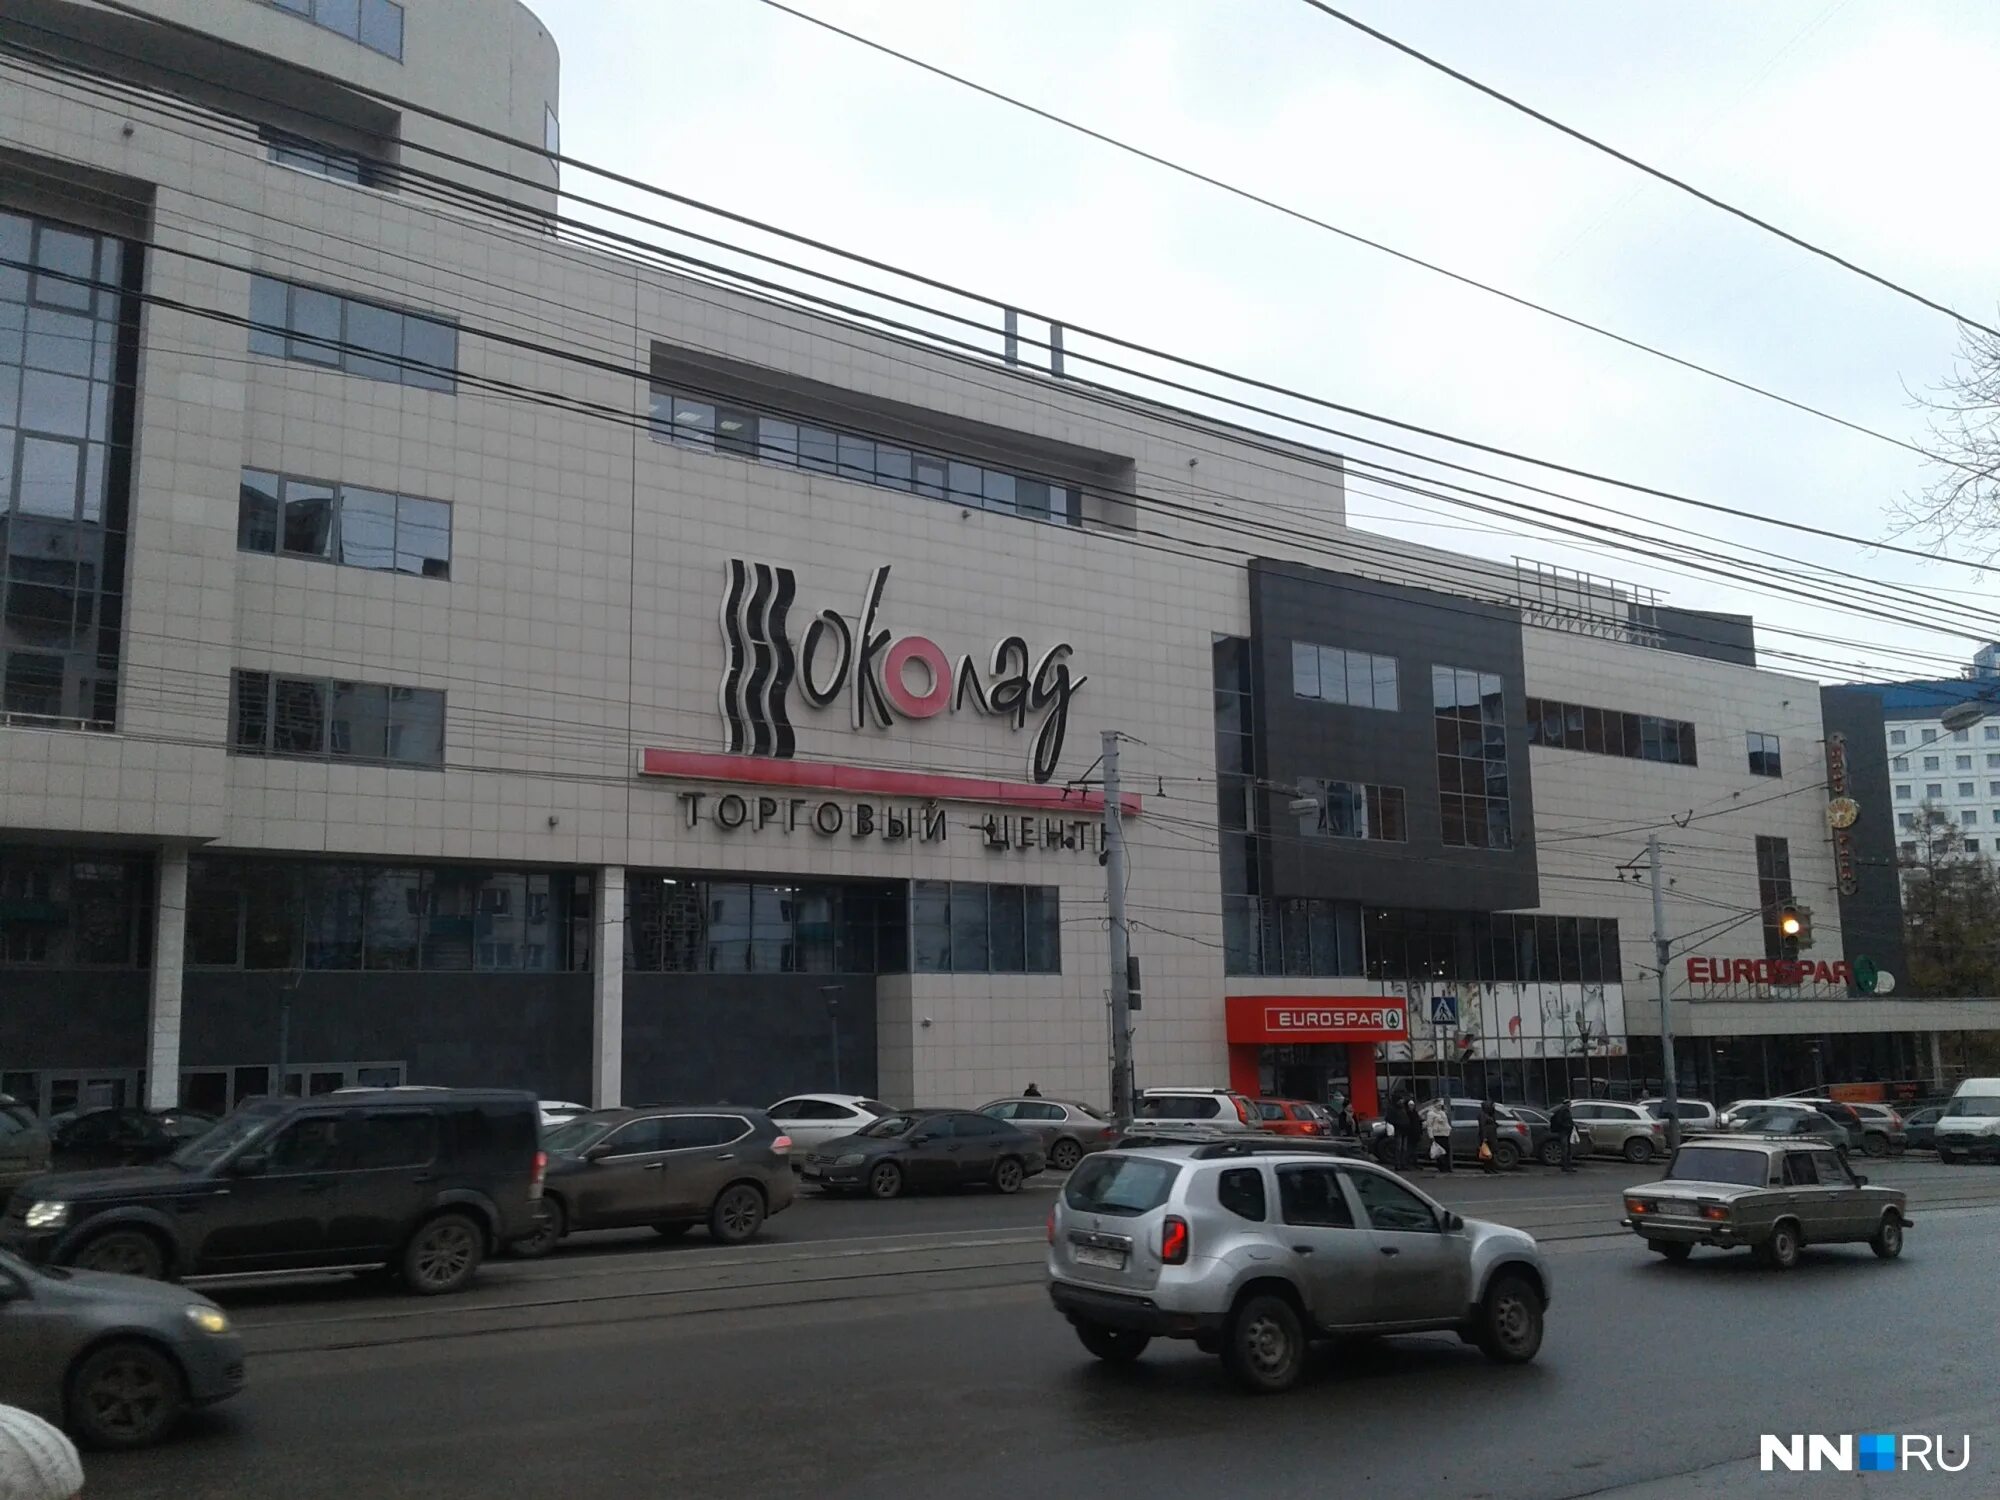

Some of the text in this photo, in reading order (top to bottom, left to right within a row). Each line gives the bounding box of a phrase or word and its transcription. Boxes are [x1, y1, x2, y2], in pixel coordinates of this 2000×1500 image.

[677, 791, 948, 842] ТОРГОВЫЙ
[1687, 957, 1852, 986] EUROSPAR
[1278, 1012, 1383, 1026] EUROSPAR
